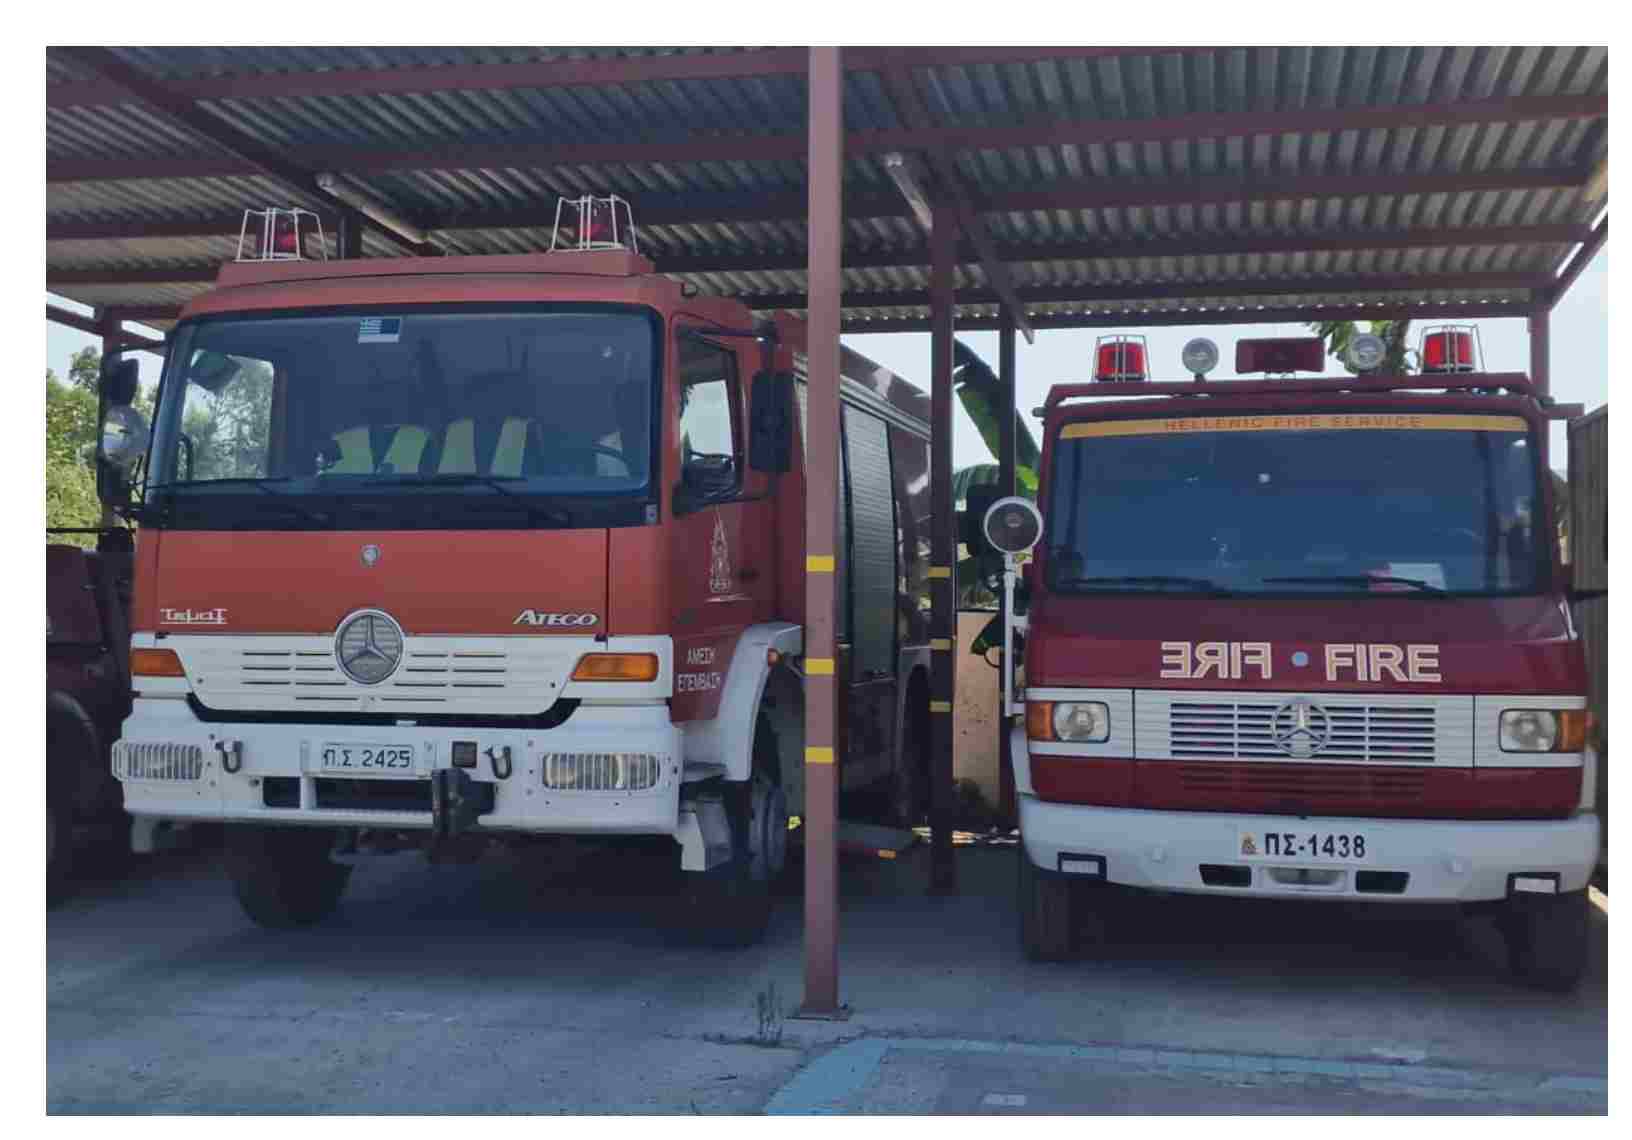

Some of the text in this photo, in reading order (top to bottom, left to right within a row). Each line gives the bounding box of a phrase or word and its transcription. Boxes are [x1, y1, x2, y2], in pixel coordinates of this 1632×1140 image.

[1167, 414, 1424, 431] HELLENIC FIRE SERVICE
[1324, 643, 1442, 682] FIRE
[362, 749, 410, 768] 2425
[1264, 832, 1366, 858] ΠΣ-1438
